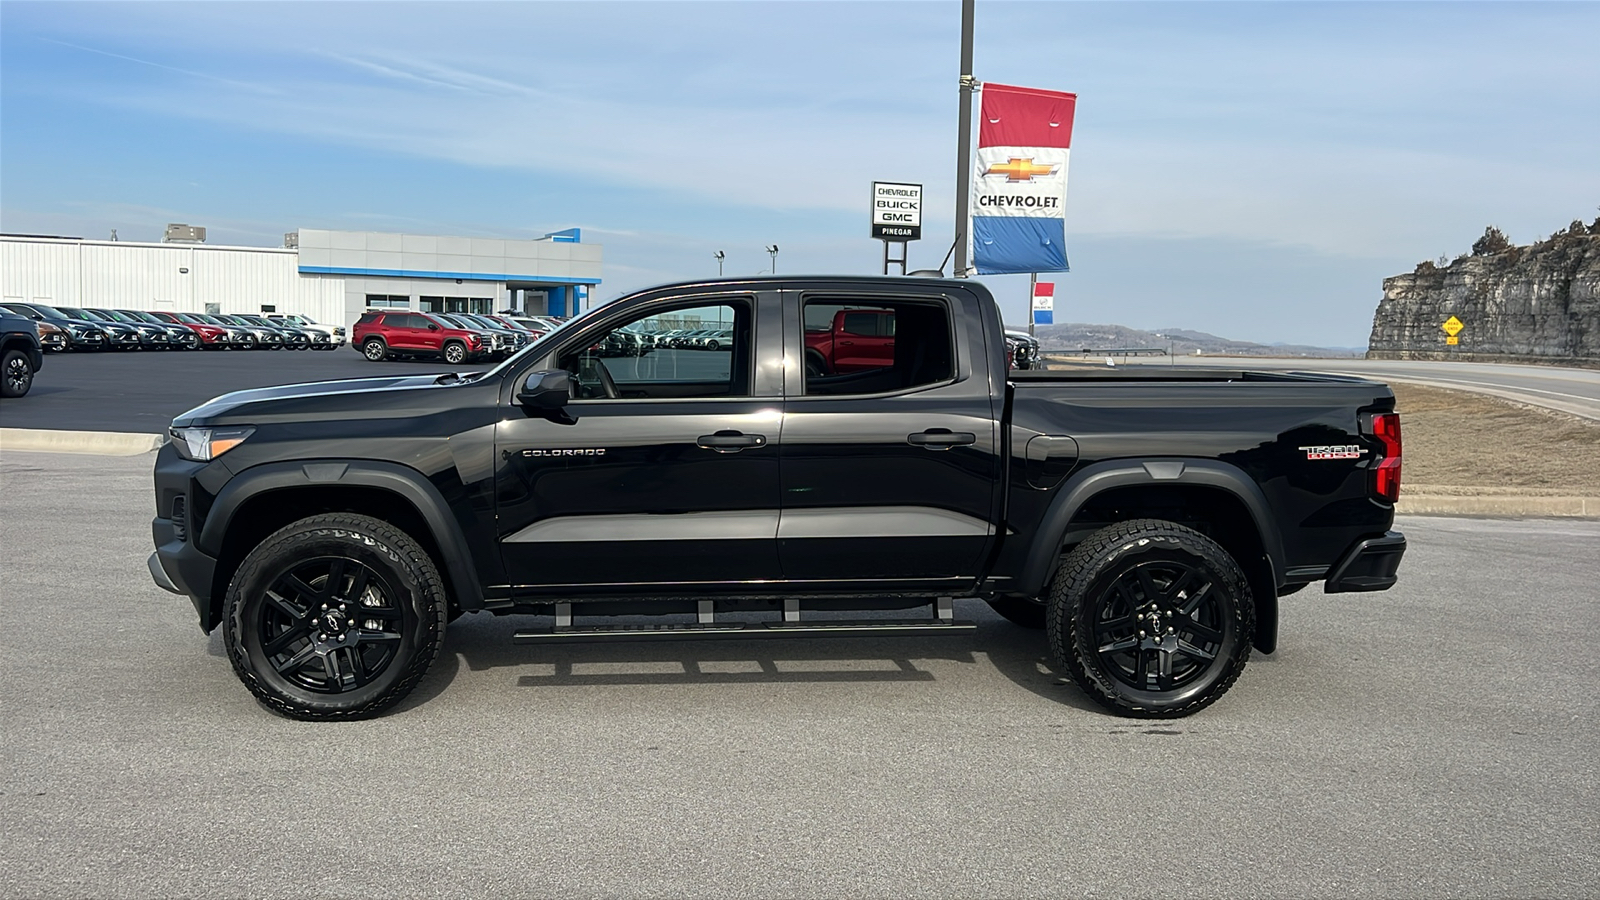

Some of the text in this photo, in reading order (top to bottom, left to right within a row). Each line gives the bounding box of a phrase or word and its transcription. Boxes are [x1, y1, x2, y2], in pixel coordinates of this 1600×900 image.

[878, 188, 918, 197] CHEVROLET
[877, 200, 918, 210] BUICK
[980, 195, 1058, 208] CHEVROLET
[882, 213, 912, 222] GMC
[882, 228, 912, 236] PINEGAR
[522, 448, 606, 457] COLORADO
[1299, 445, 1368, 454] TRAIL
